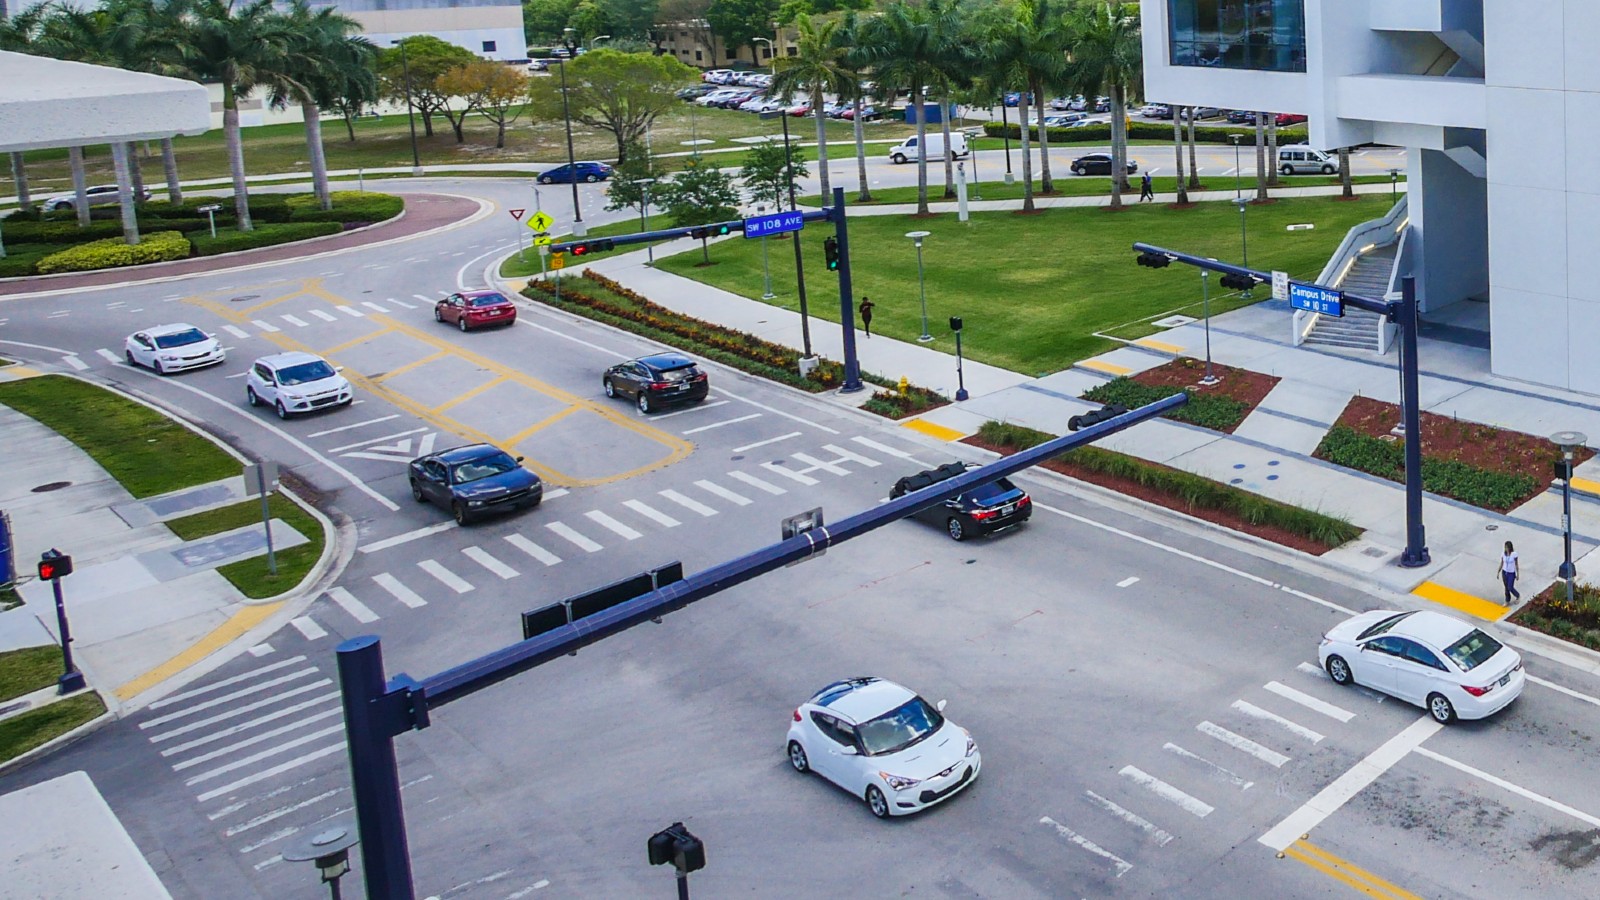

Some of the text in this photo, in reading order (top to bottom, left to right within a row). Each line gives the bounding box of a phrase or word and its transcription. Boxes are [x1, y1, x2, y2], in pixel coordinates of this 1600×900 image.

[747, 216, 802, 232] SW 108 AVE
[1291, 285, 1319, 299] Campus
[1321, 291, 1340, 303] Drive
[1312, 301, 1320, 310] 10
